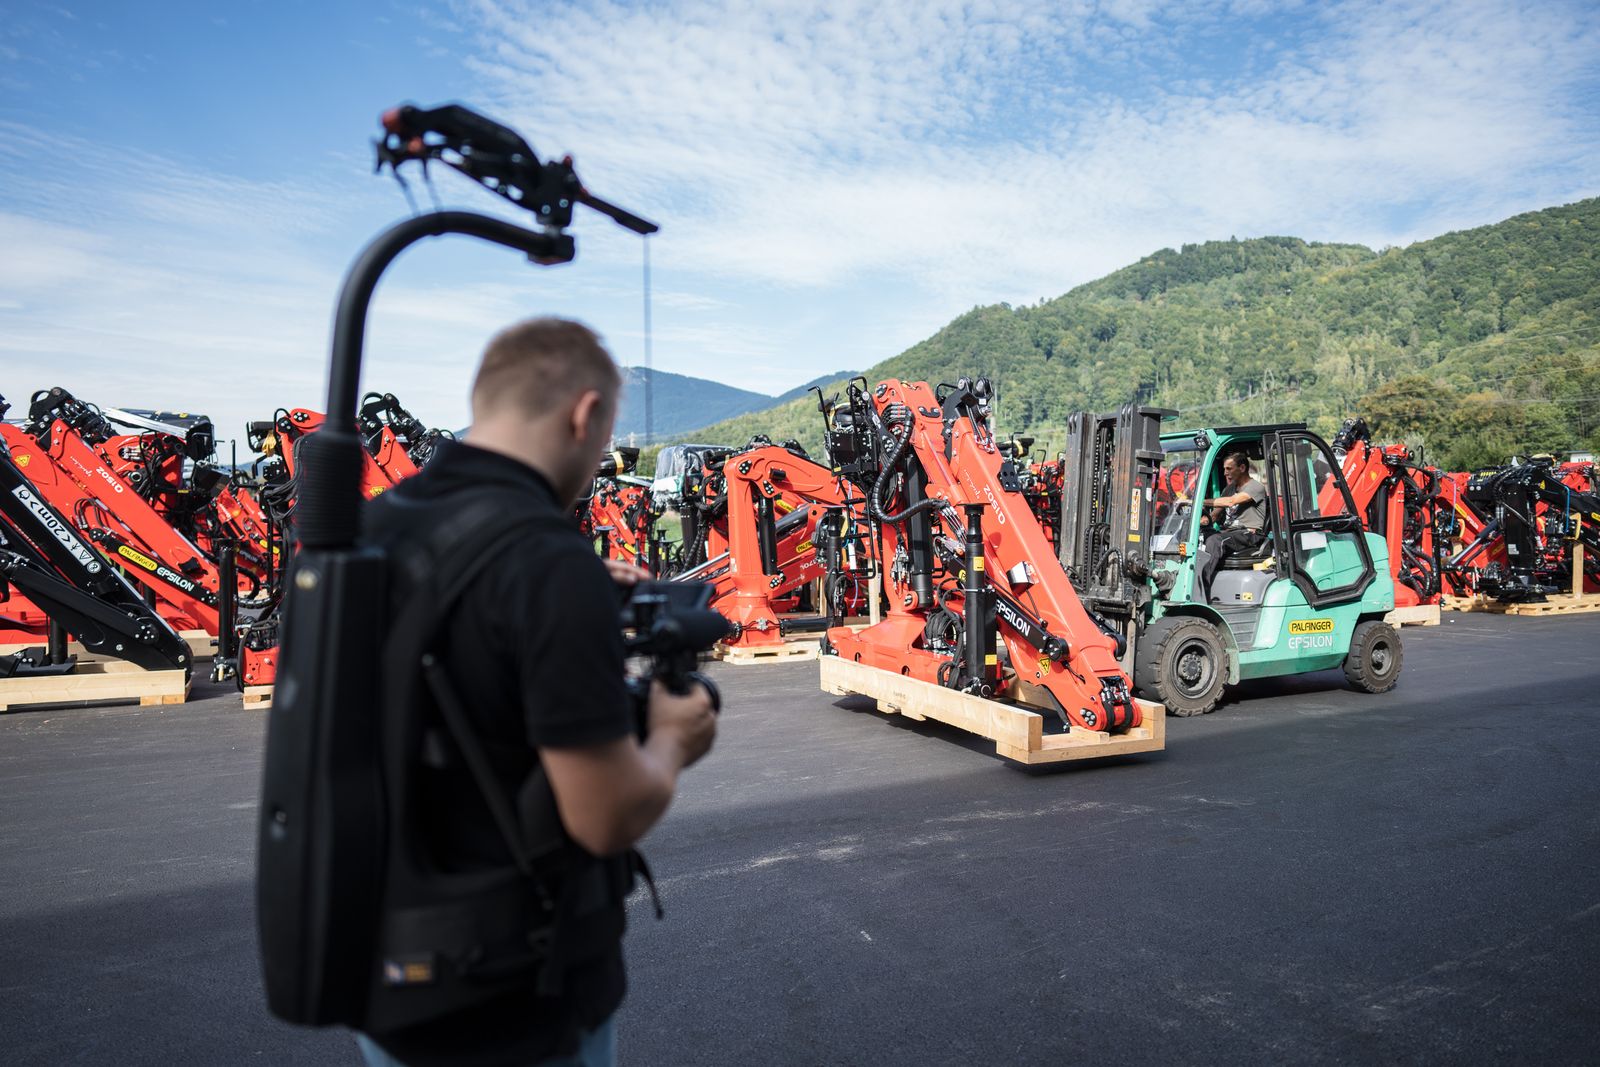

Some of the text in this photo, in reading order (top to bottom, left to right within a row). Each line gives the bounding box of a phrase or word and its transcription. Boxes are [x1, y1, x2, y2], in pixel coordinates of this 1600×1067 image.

[983, 483, 1006, 525] Q150Z
[37, 507, 66, 536] 20m
[120, 547, 195, 592] PALFINGER EPSILON
[1291, 620, 1332, 632] PALFINGER
[1288, 634, 1333, 650] EPSILON
